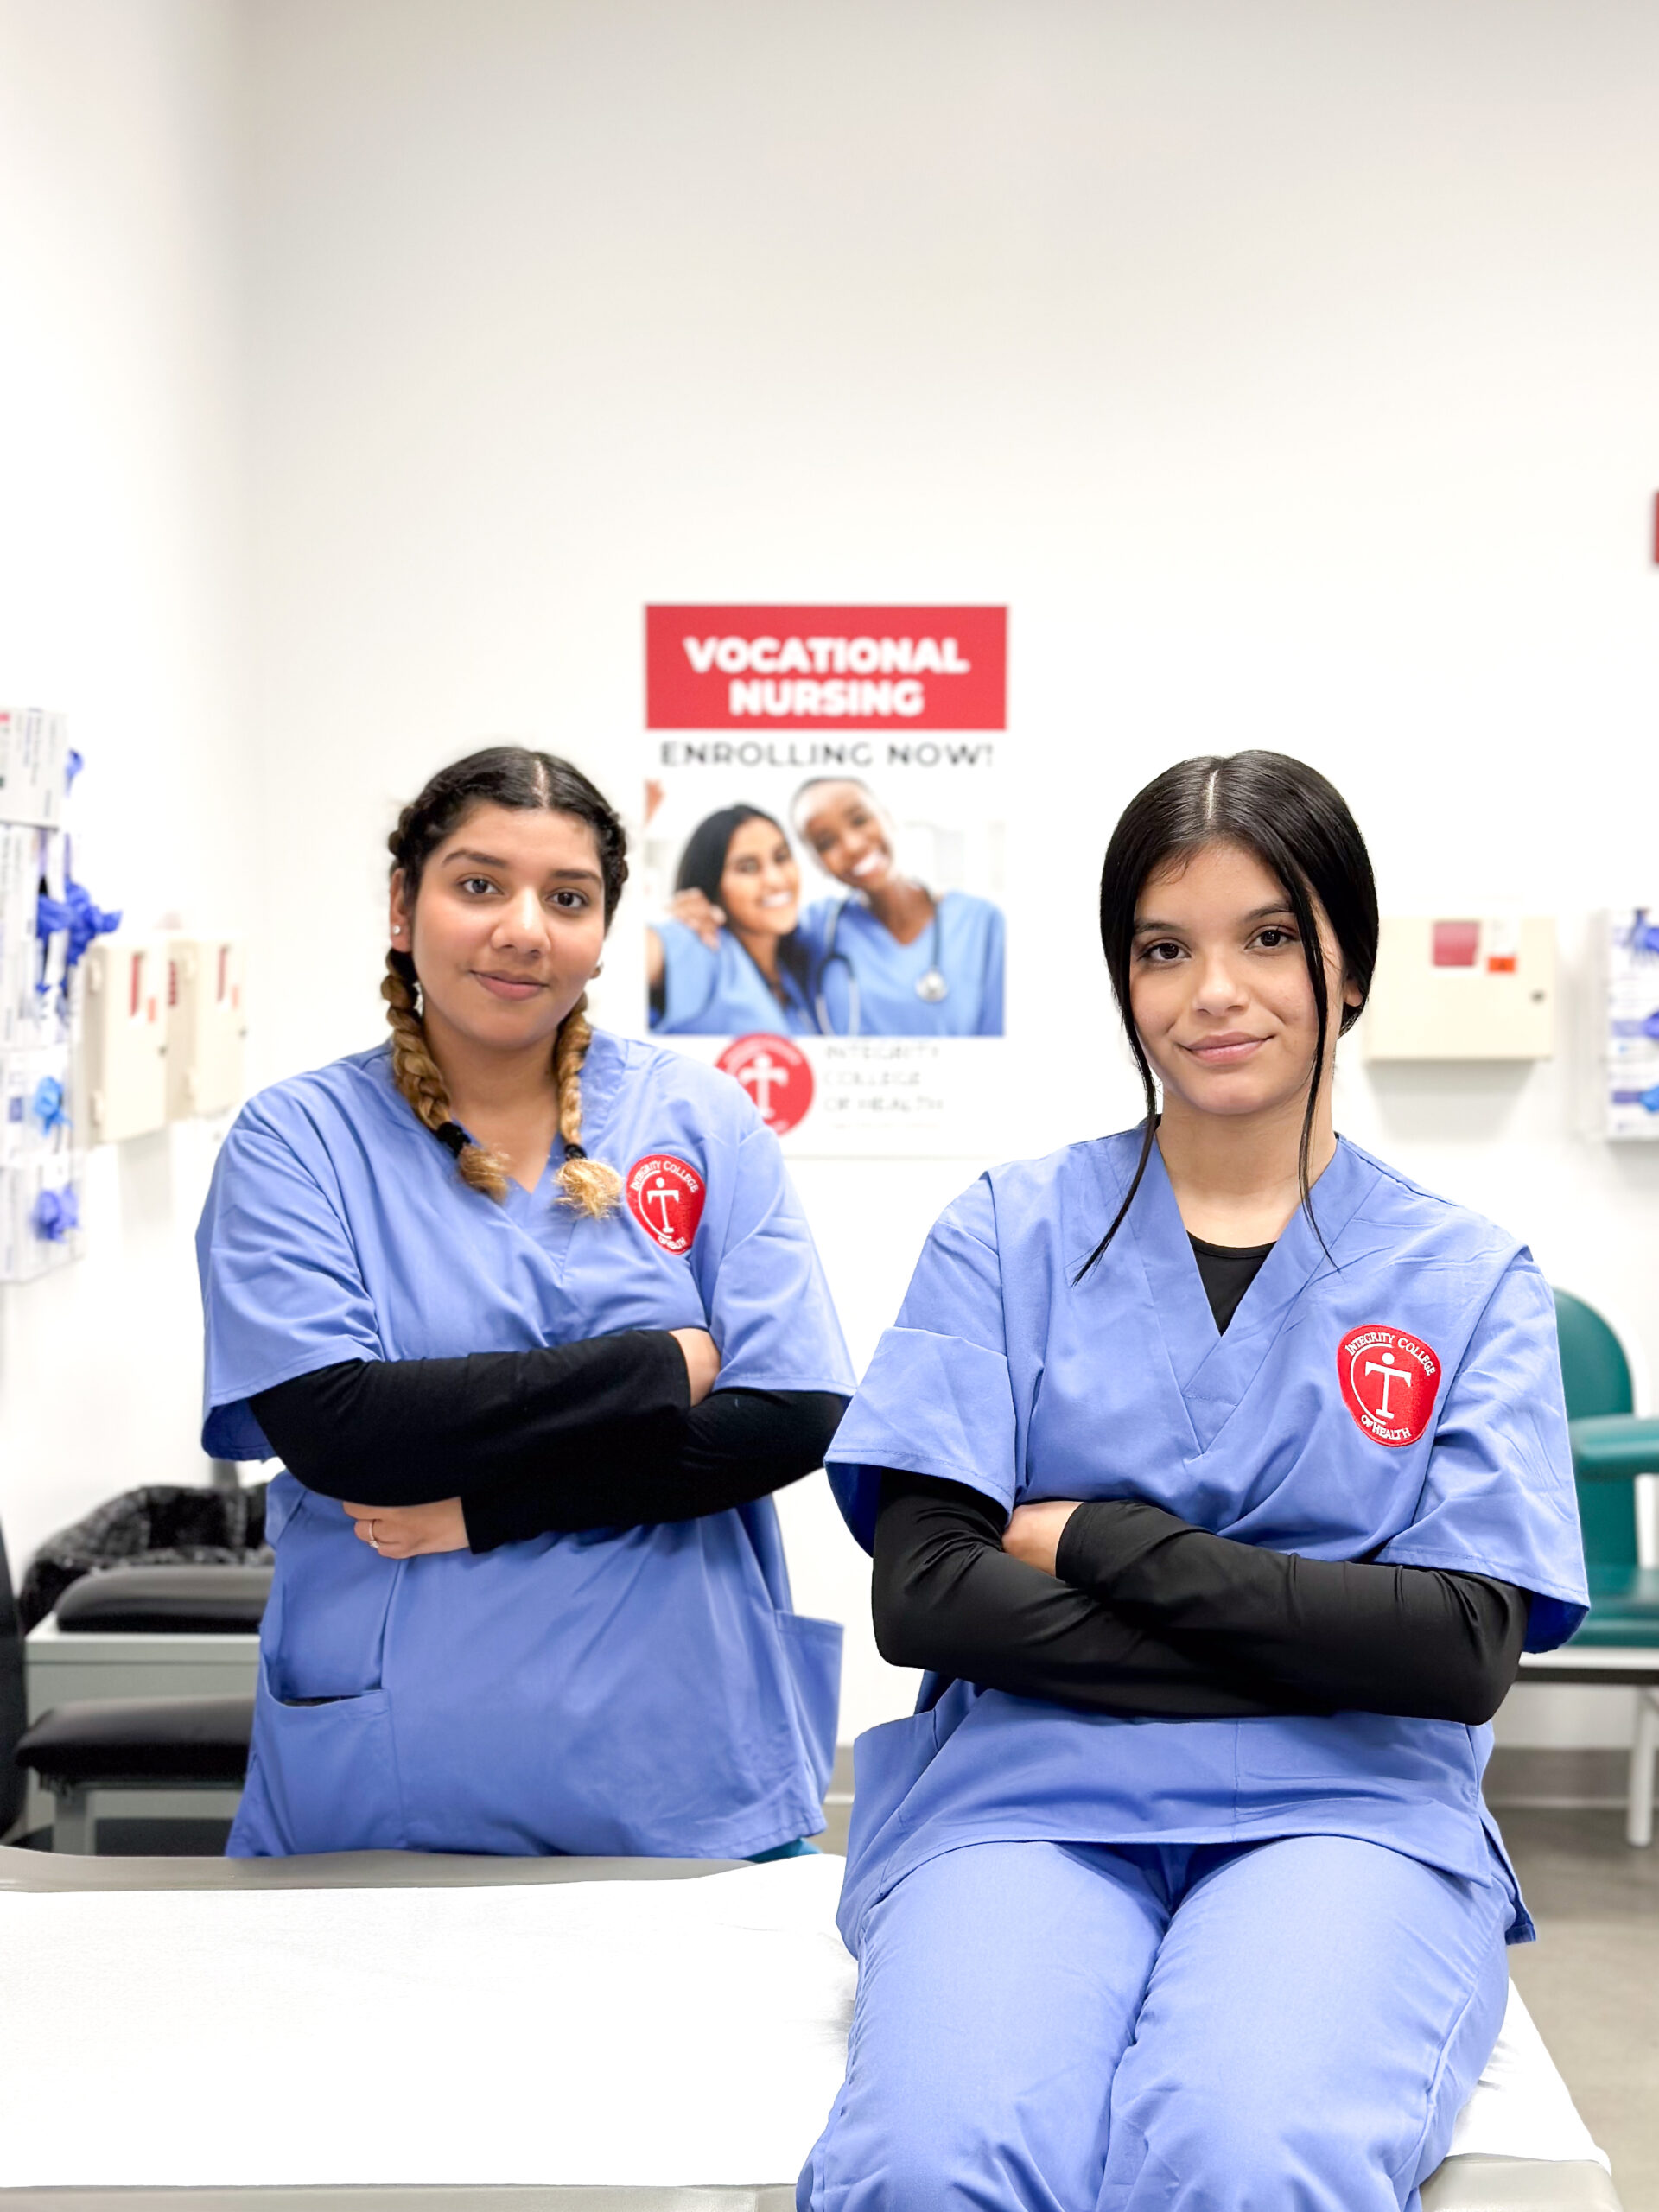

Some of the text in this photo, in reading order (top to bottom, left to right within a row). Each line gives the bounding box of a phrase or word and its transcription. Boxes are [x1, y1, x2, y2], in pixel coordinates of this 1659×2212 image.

[683, 636, 971, 674] VOCATIONAL
[728, 679, 925, 717] NURSING
[660, 741, 993, 767] ENROLLING NOW!
[630, 1160, 699, 1193] INTEGRITY COLLEGE
[1344, 1332, 1436, 1376] INTEGRITY COLLEGE
[1372, 1421, 1412, 1440] HEALTH
